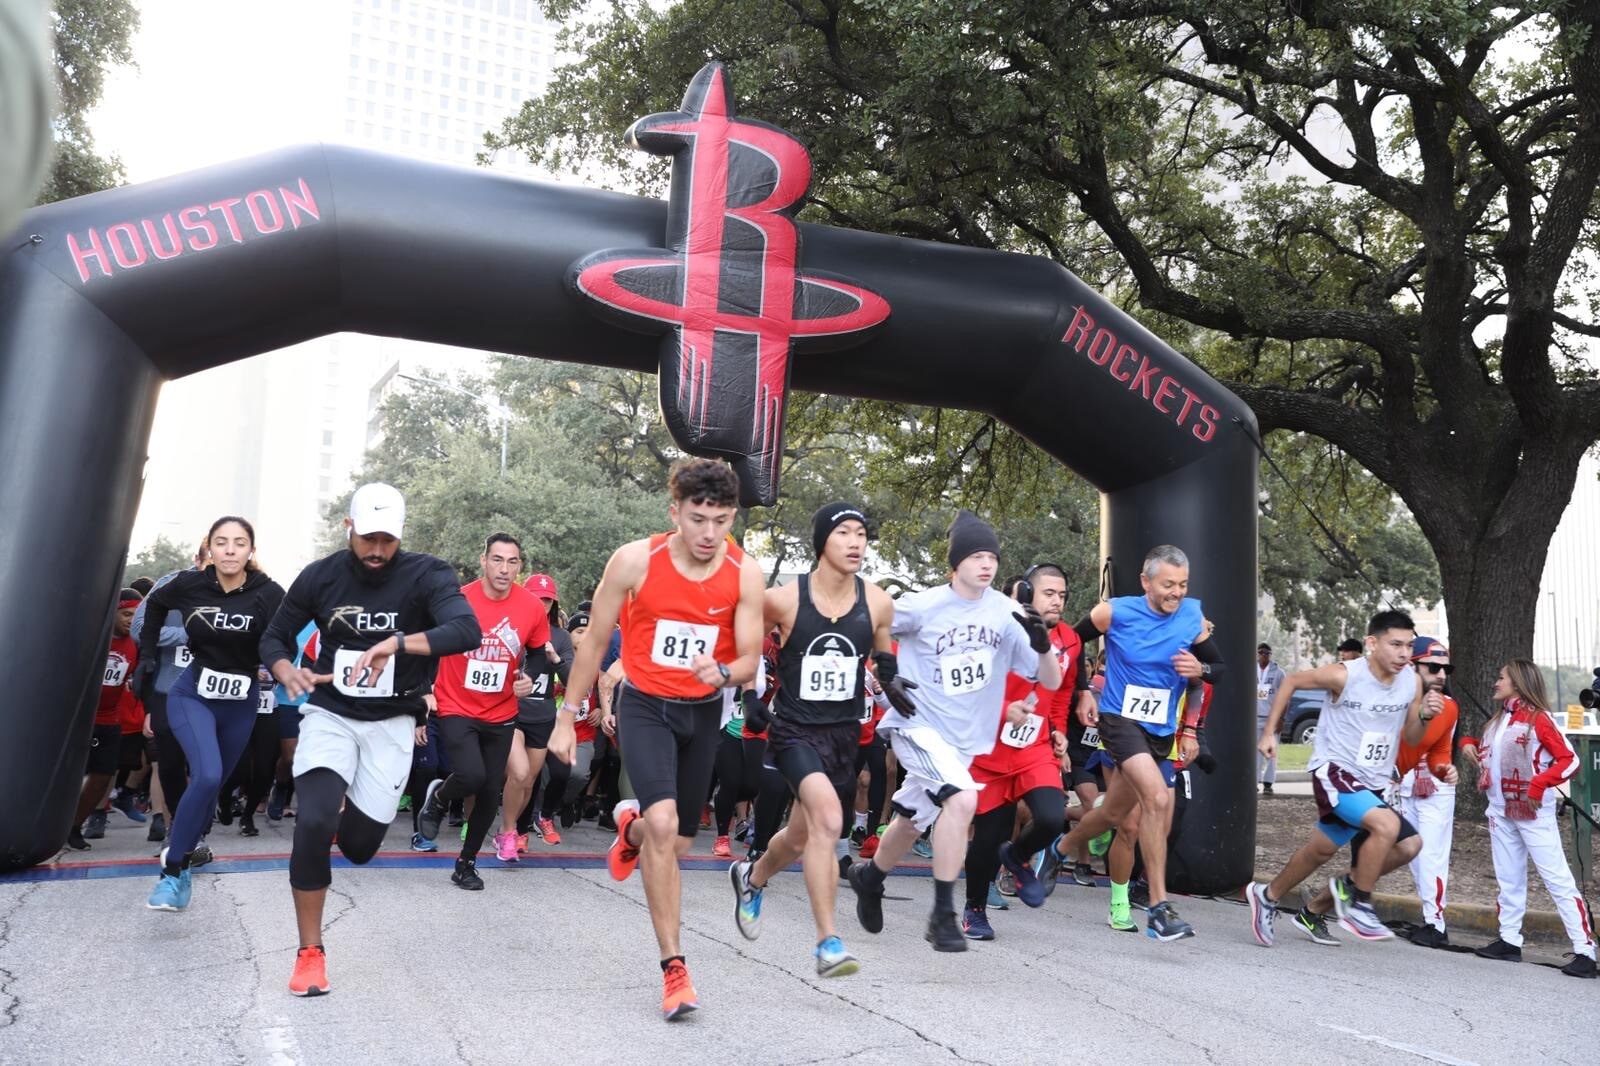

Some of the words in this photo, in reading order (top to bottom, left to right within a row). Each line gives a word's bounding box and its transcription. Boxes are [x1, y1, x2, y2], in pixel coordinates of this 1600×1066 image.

[66, 177, 320, 283] HOUSTON
[1061, 304, 1221, 442] ROCKETS
[663, 635, 706, 659] 813
[105, 668, 121, 682] 04
[206, 675, 242, 697] 908
[472, 670, 499, 687] 981
[810, 670, 847, 692] 951
[951, 663, 985, 687] 934
[1129, 697, 1161, 716] 747
[1009, 725, 1035, 743] 817
[1364, 743, 1390, 761] 353
